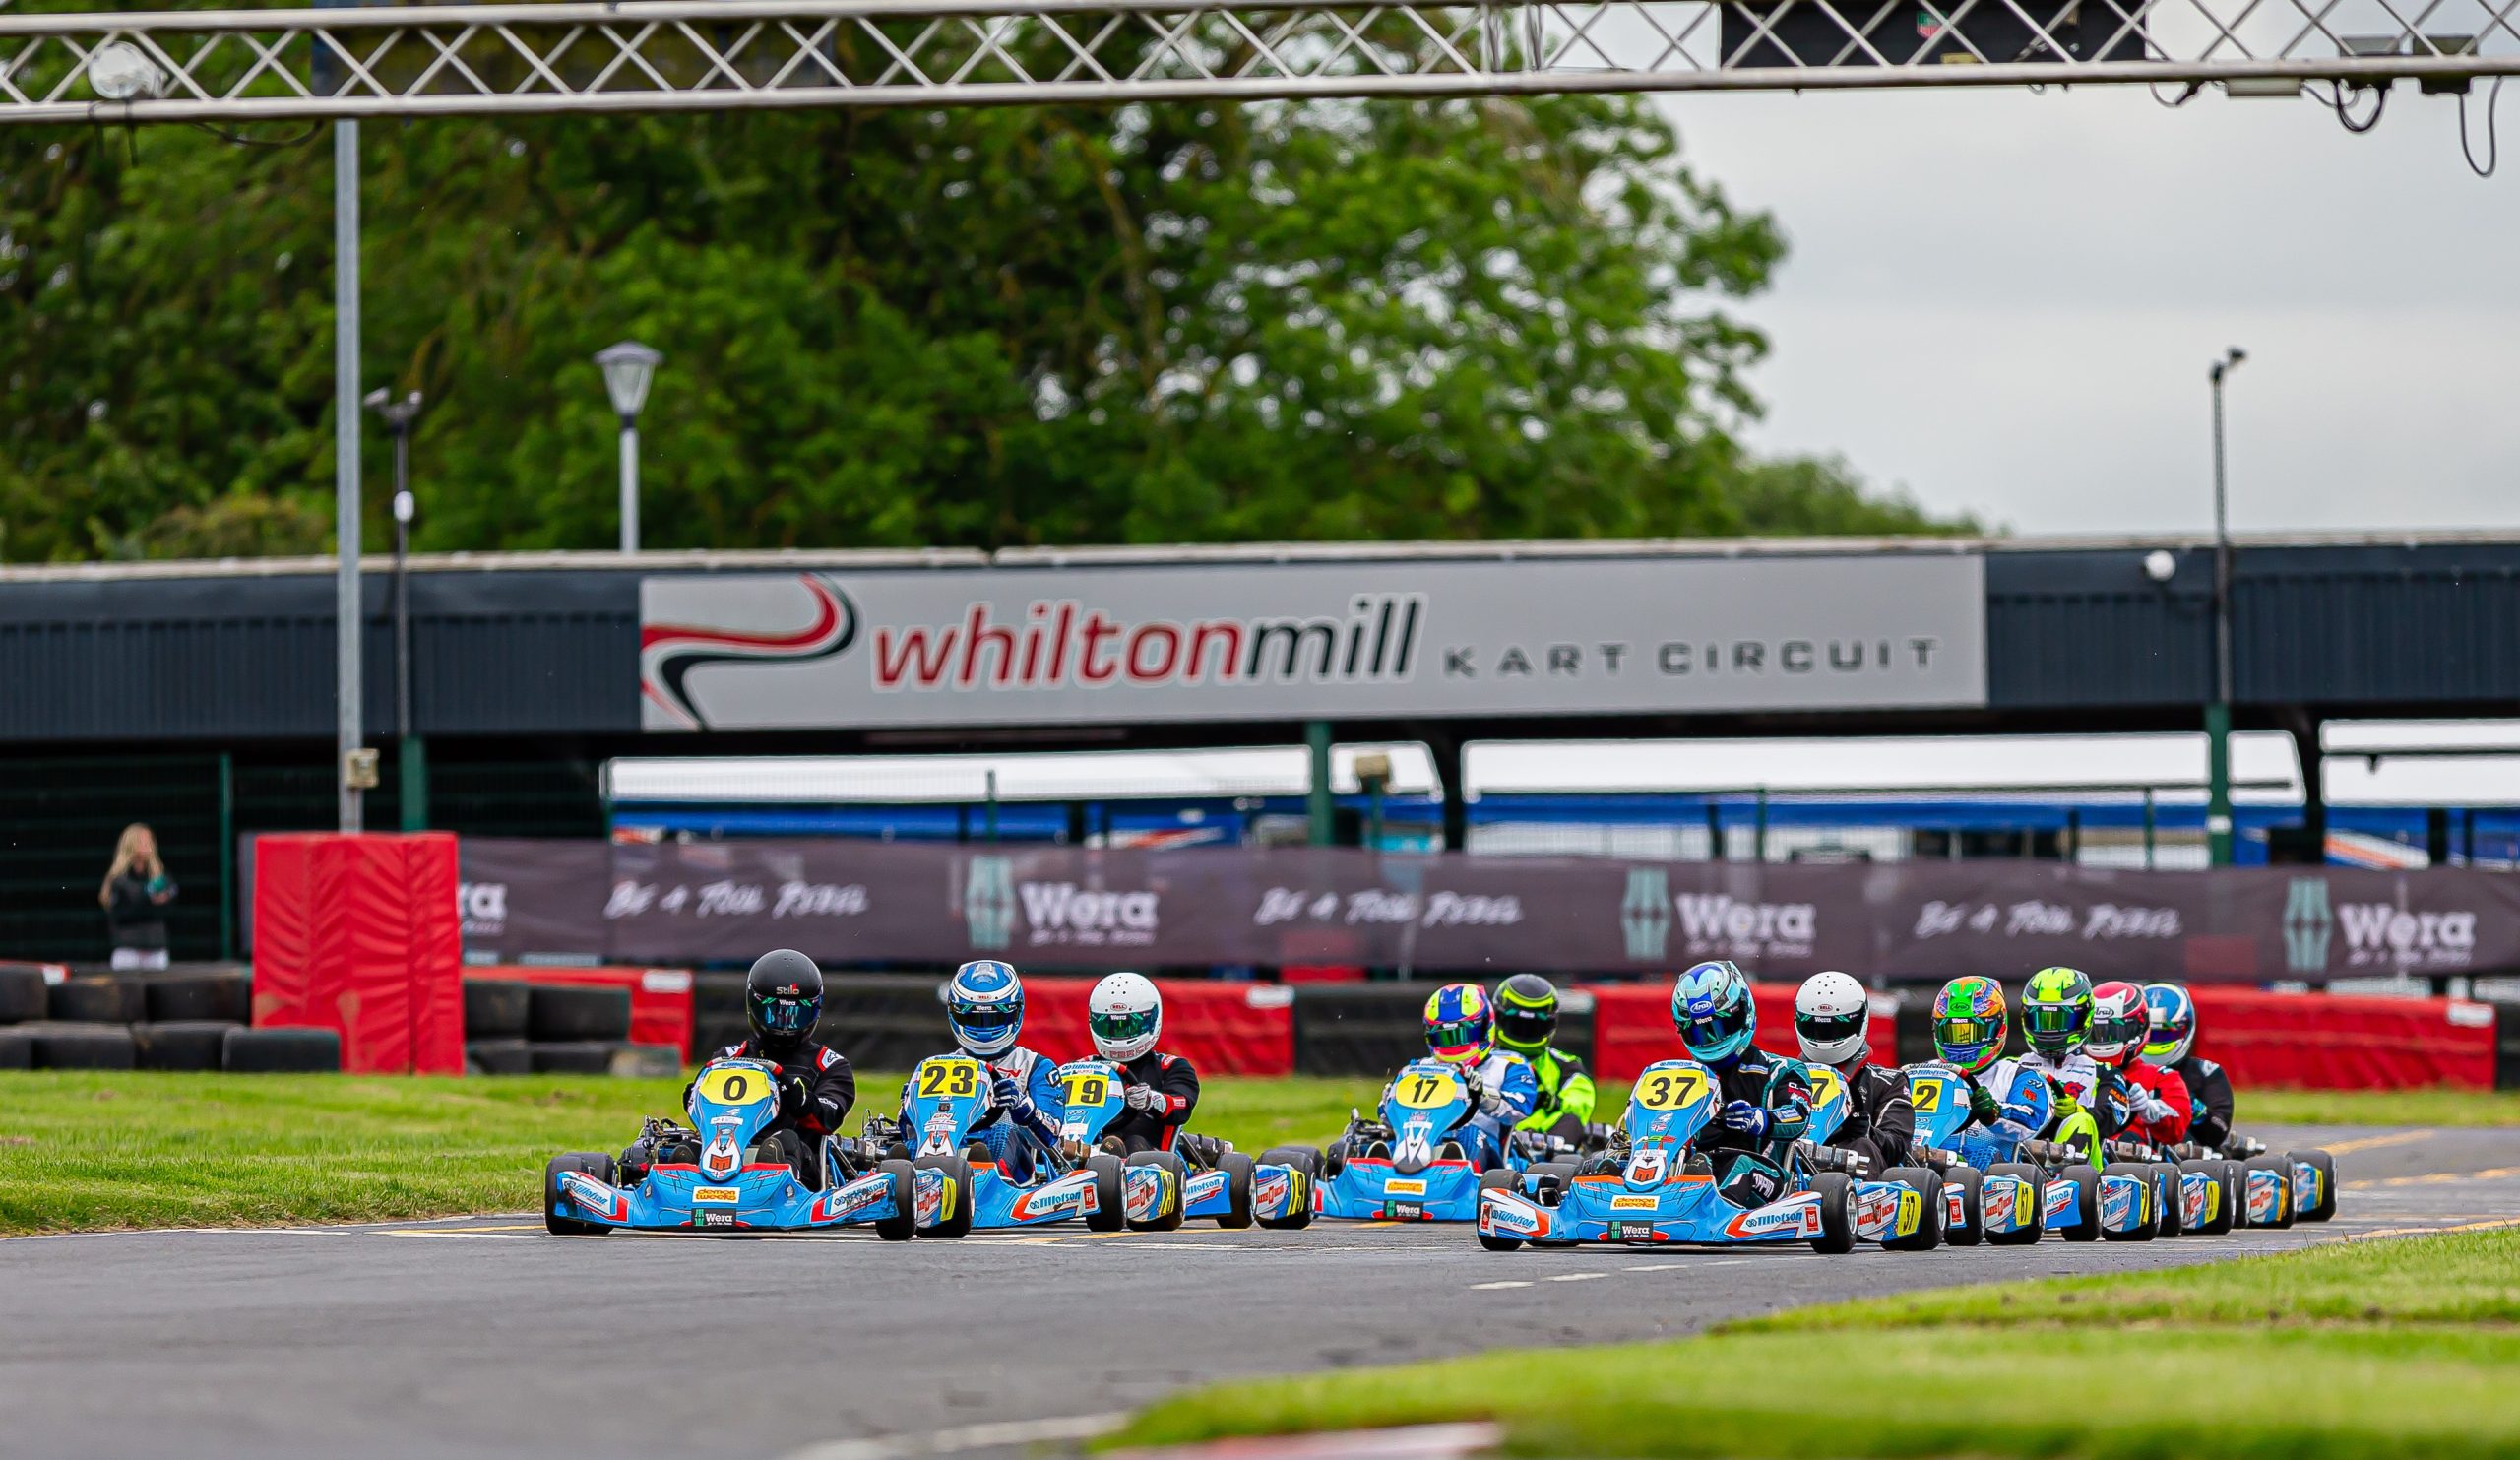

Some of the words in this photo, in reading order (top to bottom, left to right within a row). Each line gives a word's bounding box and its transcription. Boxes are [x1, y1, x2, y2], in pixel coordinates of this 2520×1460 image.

[873, 597, 1423, 685] whiltonmill
[1444, 642, 1628, 677] KART
[1658, 638, 1938, 674] CIRCUIT
[776, 984, 800, 995] Stilo
[723, 1075, 748, 1102] 0
[922, 1065, 974, 1096] 23
[1064, 1079, 1104, 1104] 19
[1412, 1079, 1440, 1104] 17
[1646, 1076, 1697, 1107] 37
[1914, 1084, 1938, 1111] 2
[1039, 1191, 1081, 1208] Tillotson
[1396, 1204, 1420, 1215] Wera
[705, 1213, 733, 1223] Wera
[1498, 1209, 1536, 1228] Tillotson
[1756, 1212, 1803, 1227] Tillotson
[1903, 1195, 1916, 1233] 37
[1622, 1225, 1650, 1235] Wera
